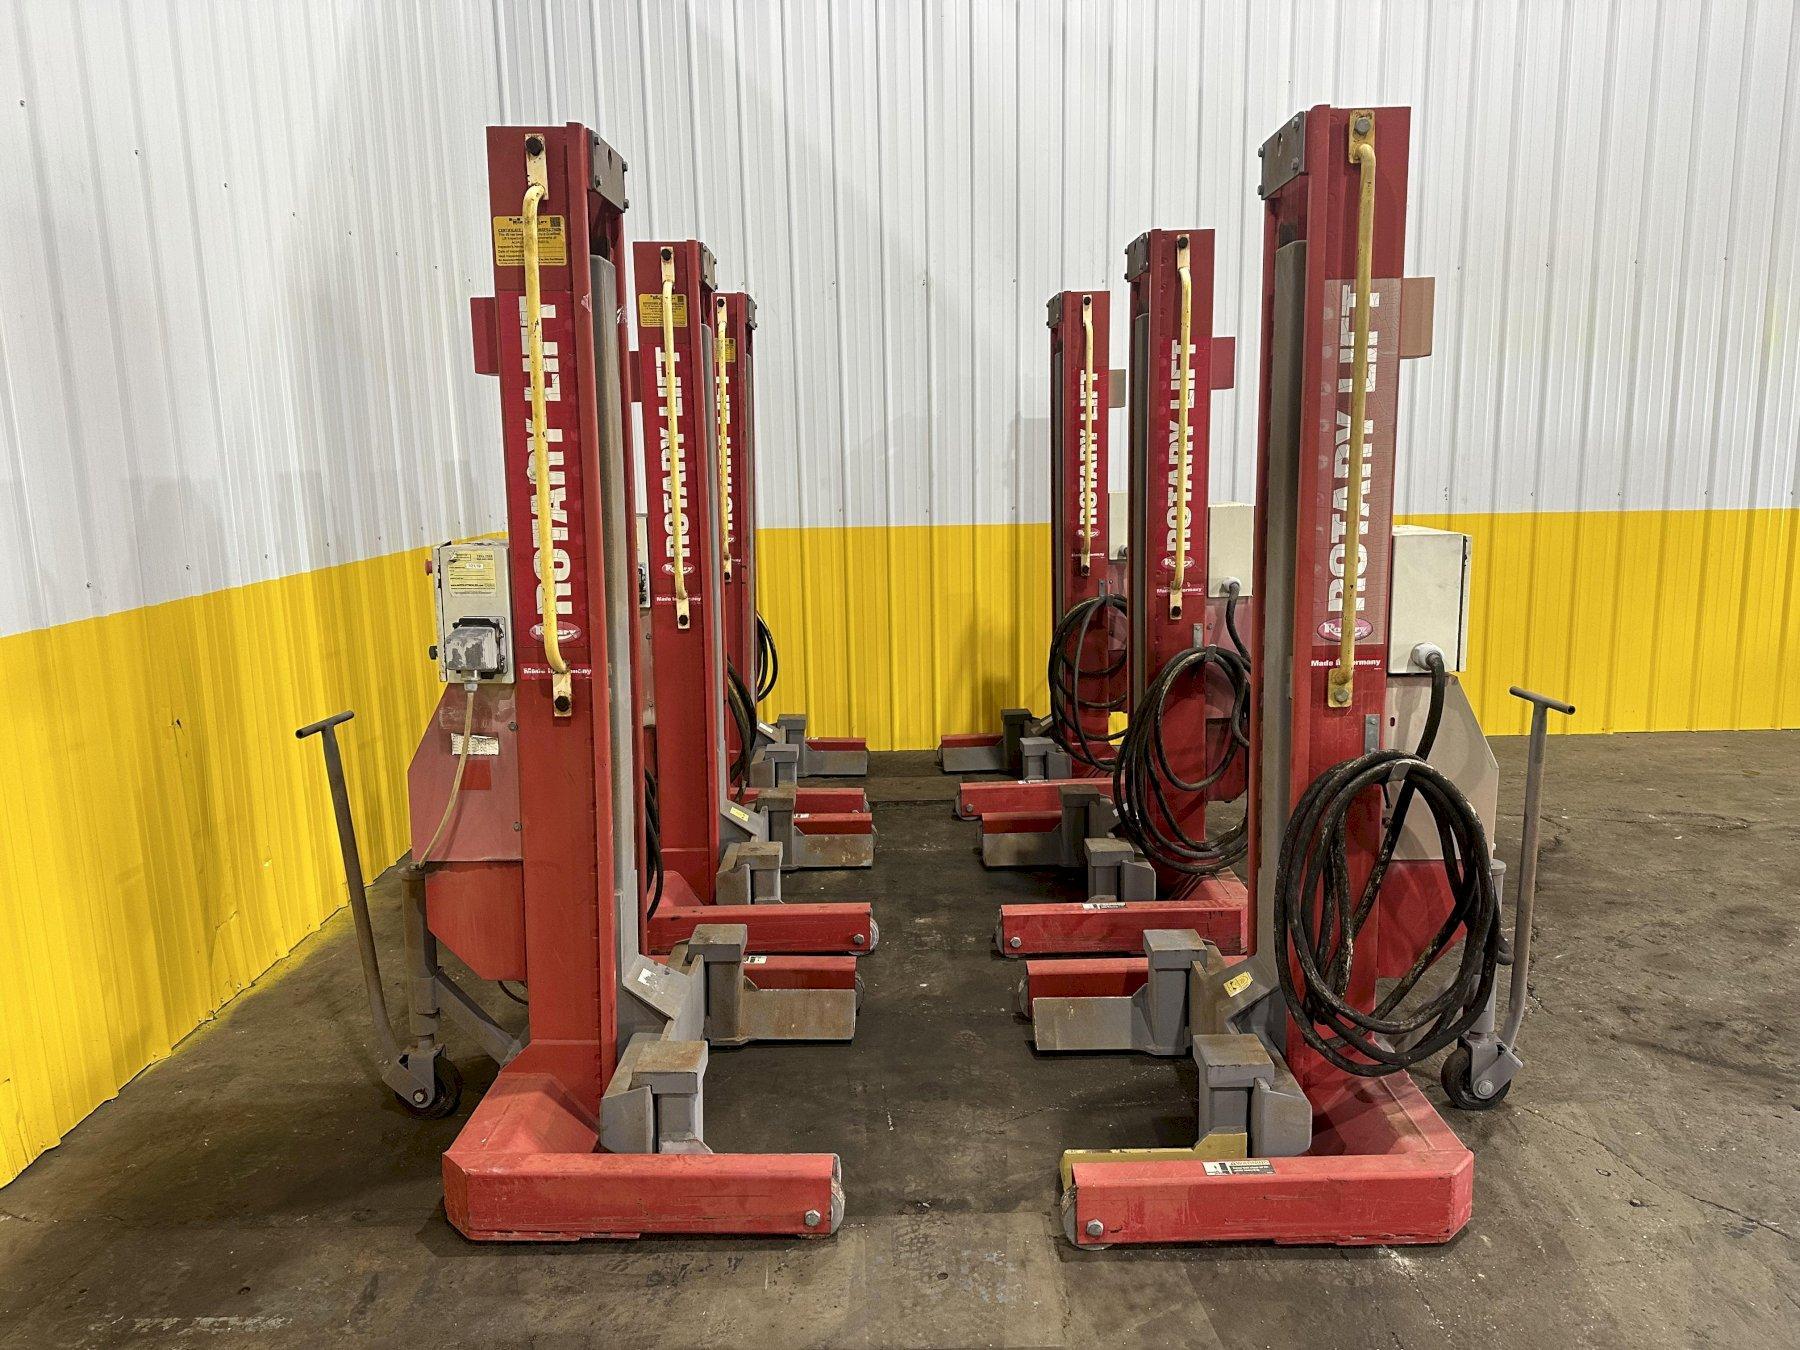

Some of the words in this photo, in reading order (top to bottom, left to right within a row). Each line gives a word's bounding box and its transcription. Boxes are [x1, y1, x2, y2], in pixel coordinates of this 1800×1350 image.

[655, 346, 684, 417] LIFT
[1170, 339, 1197, 410] LIFT
[1338, 284, 1380, 394] LIFT
[1079, 369, 1098, 421] LIFT
[659, 427, 691, 558] ROTARY
[1079, 428, 1098, 525] ROTARY
[1167, 420, 1194, 552] ROTARY
[1327, 410, 1374, 613] ROTARY
